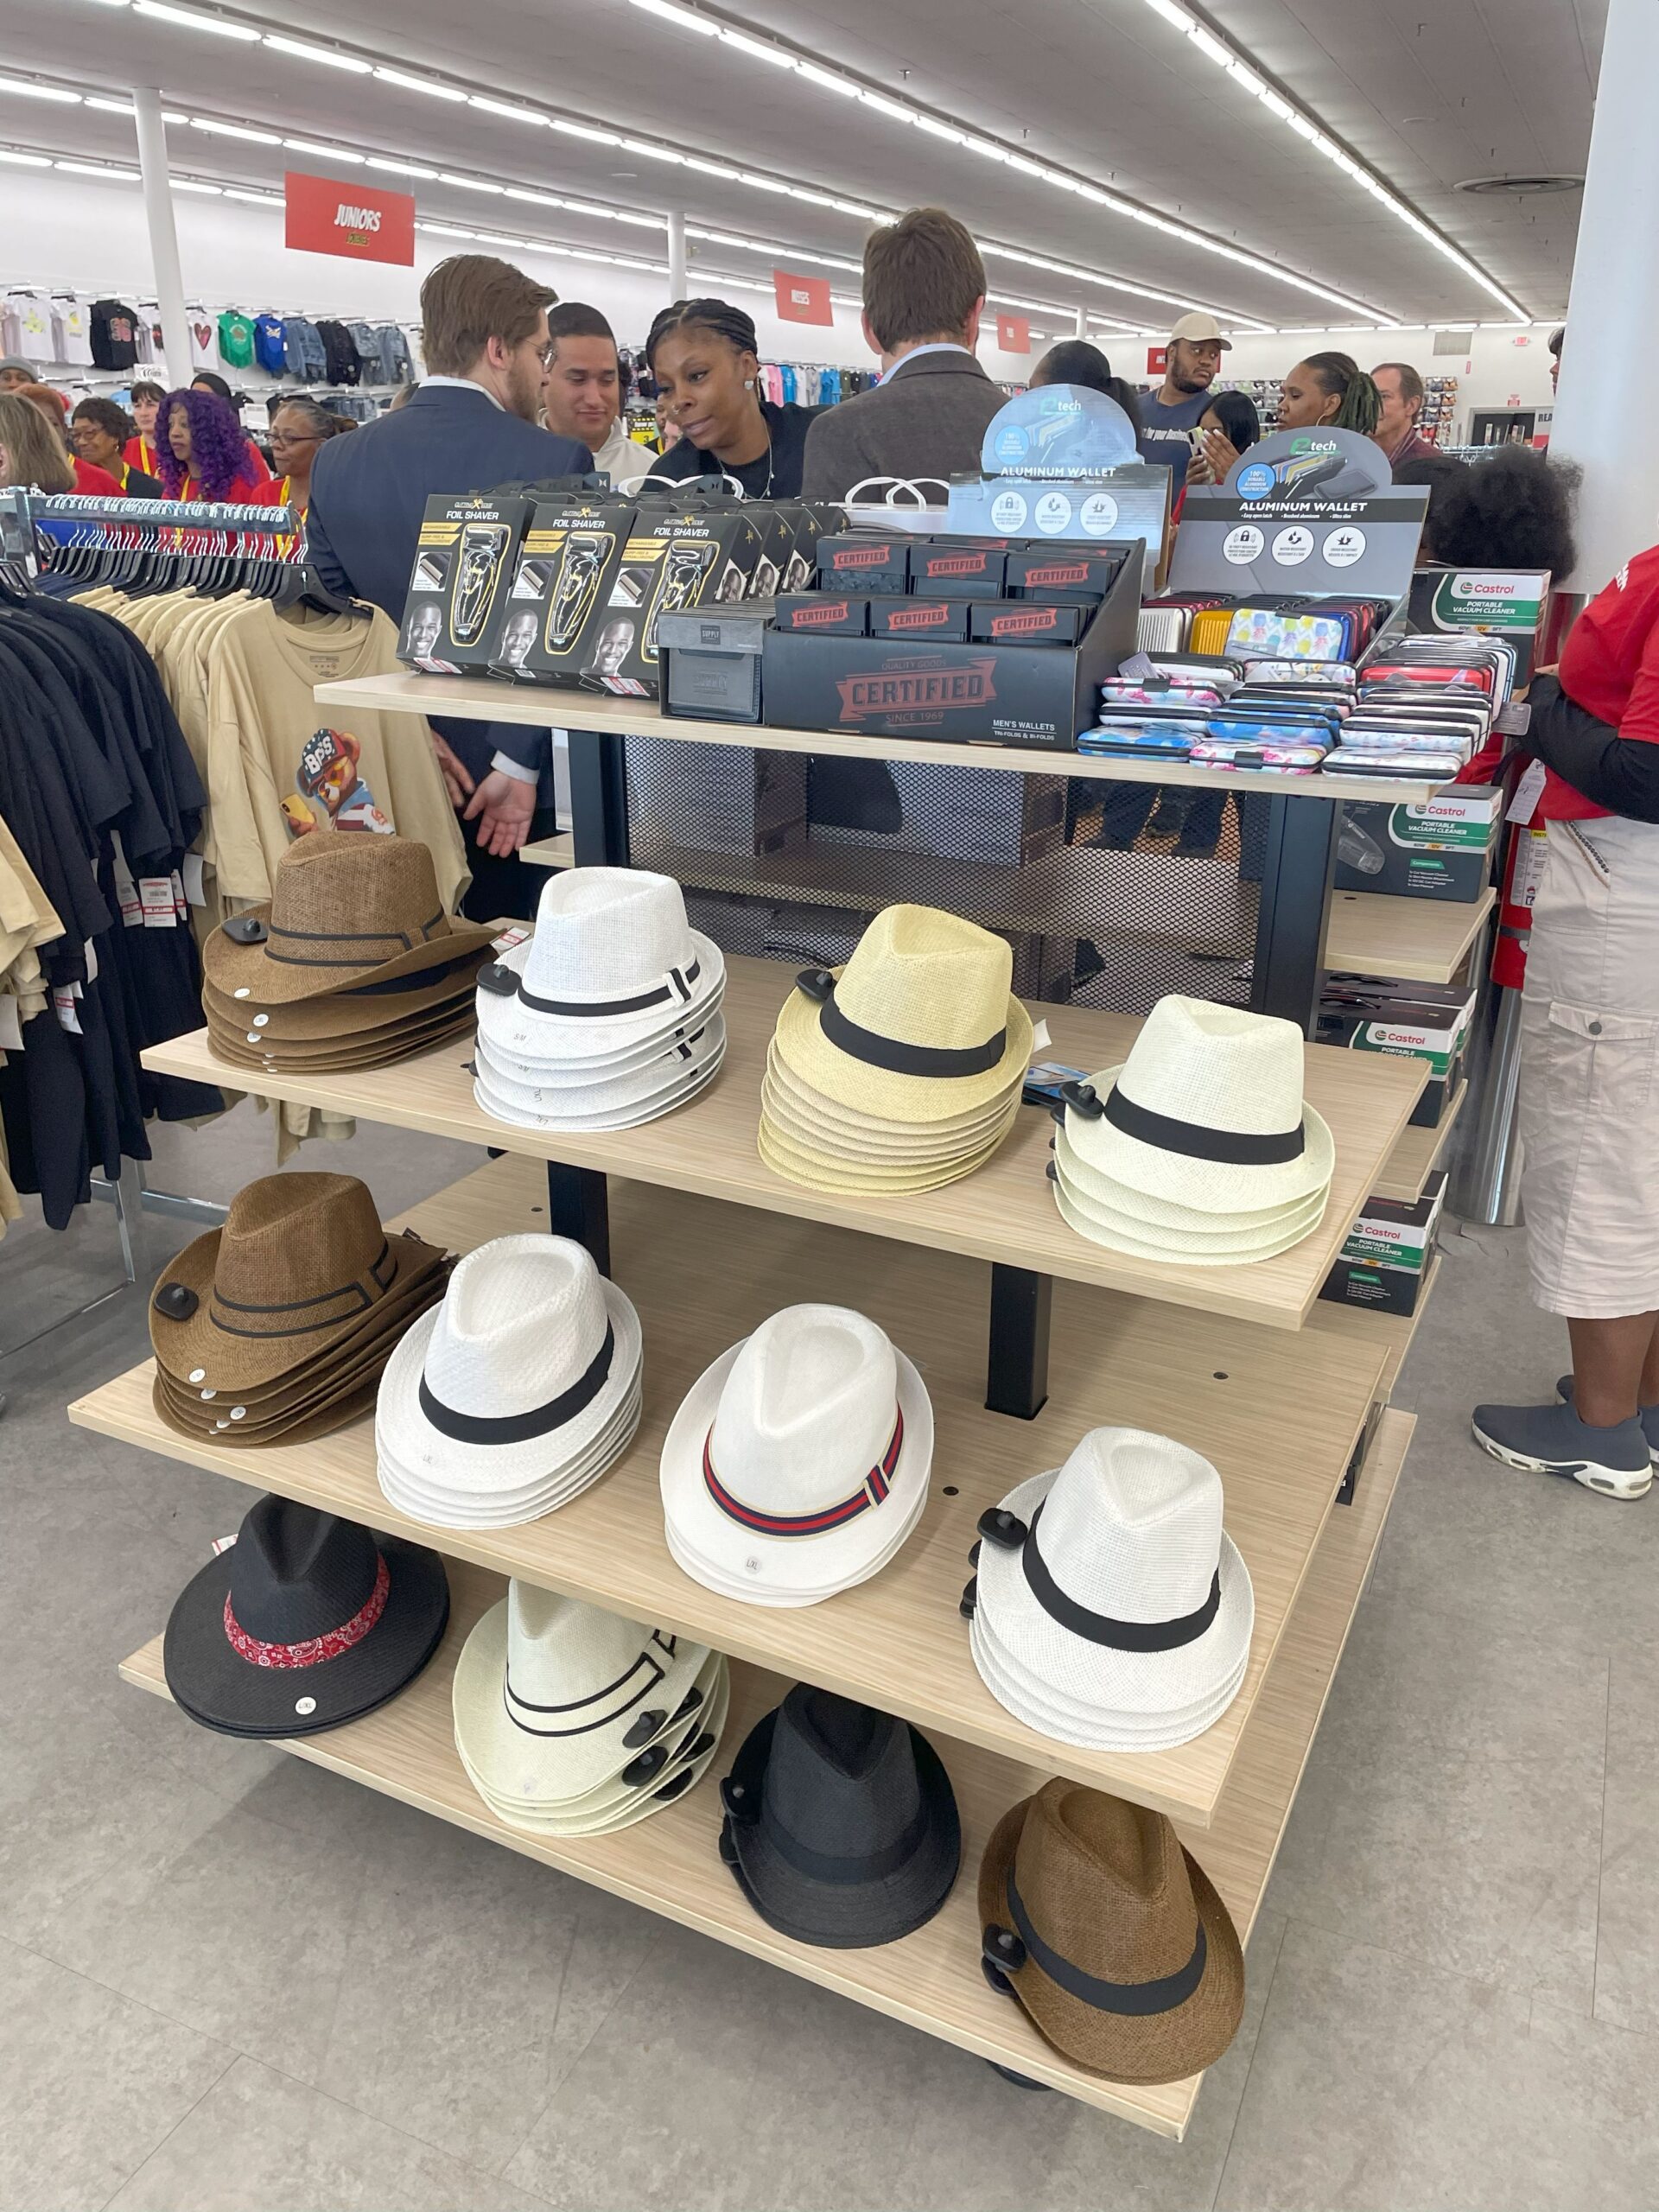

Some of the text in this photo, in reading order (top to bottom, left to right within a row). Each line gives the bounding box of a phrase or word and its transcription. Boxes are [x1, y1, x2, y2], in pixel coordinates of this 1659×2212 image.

[334, 203, 382, 232] JUNIORS
[1001, 467, 1116, 477] ALUMINUM WALLET
[1239, 502, 1368, 512] ALUMINUM WALLET
[446, 511, 499, 520] FOIL SHAVER
[552, 518, 605, 529] FOIL SHAVER
[653, 527, 709, 537] FOIL SHAVER
[838, 551, 886, 564] CERTIFIED
[932, 558, 982, 573] CERTIFIED
[1031, 568, 1084, 582] CERTIFIED
[1474, 584, 1514, 594] Castrol
[797, 608, 844, 621] CERTIFIED
[893, 611, 944, 626] CERTIFIED
[997, 615, 1052, 631] CERTIFIED
[702, 630, 720, 639] SUPPLY
[881, 659, 946, 671] QUALITY GOODS
[852, 675, 983, 705] CERTIFIED
[886, 711, 944, 723] SINCE 1969
[993, 720, 1055, 732] MEN'S WALLETS
[1427, 805, 1465, 817] Castrol
[1389, 1033, 1426, 1045] Castrol
[1382, 1046, 1415, 1056] PORTABLE
[1364, 1226, 1401, 1239] Castrol
[1346, 1242, 1373, 1251] VACUUM
[1373, 1247, 1402, 1256] CLEANER
[1359, 1239, 1391, 1249] PORTABLE
[747, 1559, 758, 1570] L/XL
